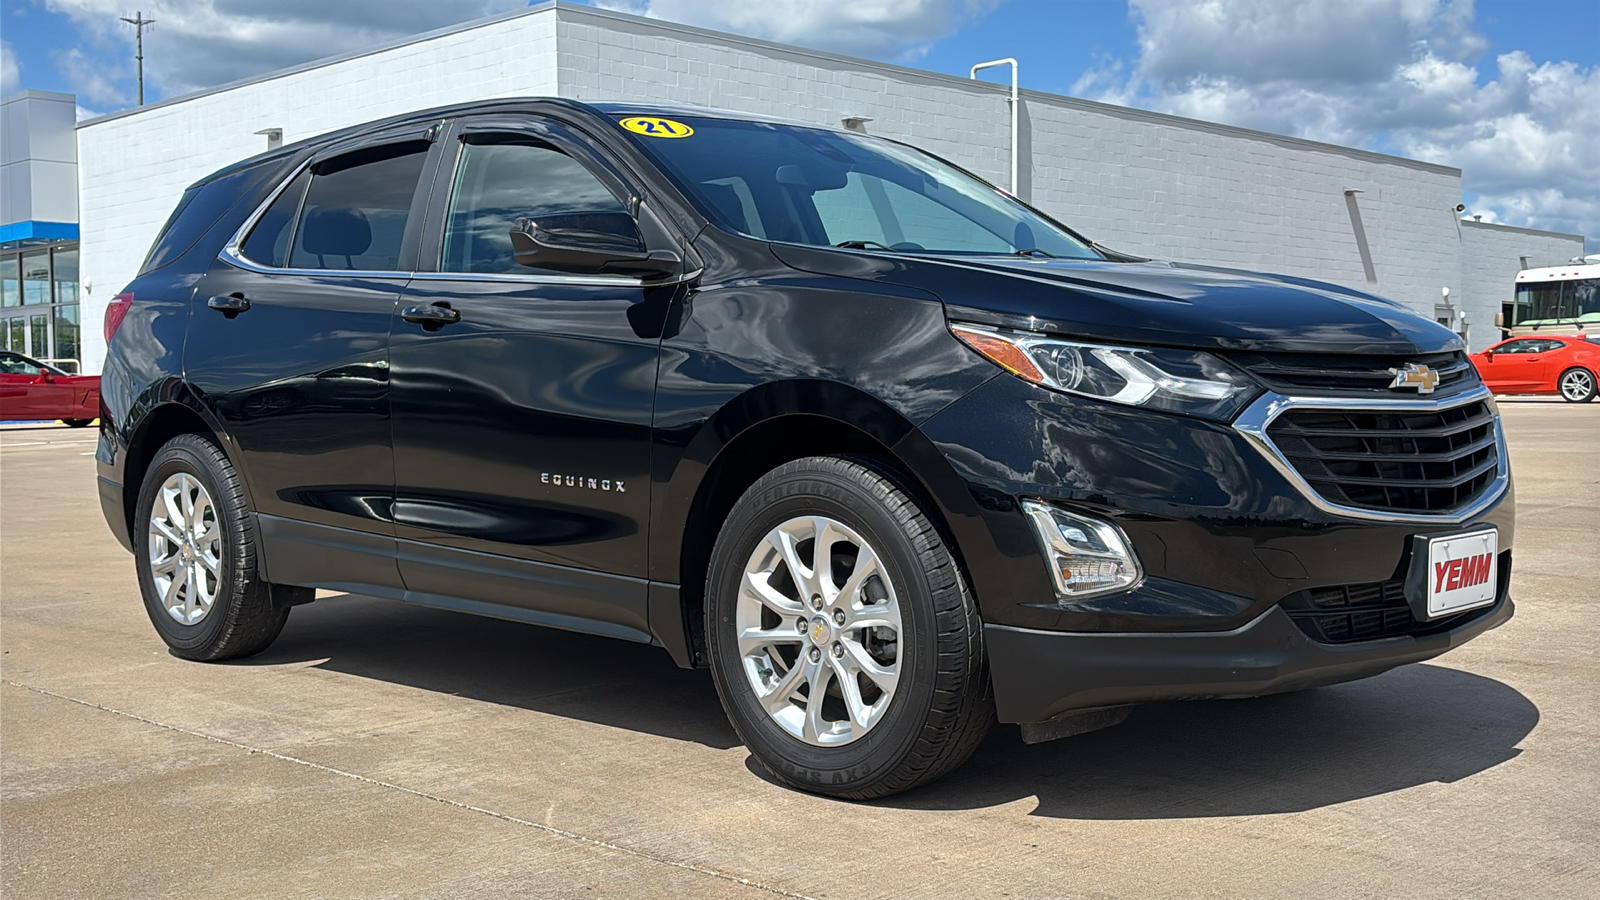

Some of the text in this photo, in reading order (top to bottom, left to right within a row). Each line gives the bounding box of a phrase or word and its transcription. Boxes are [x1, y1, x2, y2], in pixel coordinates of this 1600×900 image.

[637, 120, 677, 134] 21
[541, 472, 625, 492] EQUINOX
[1434, 552, 1493, 594] YEMM
